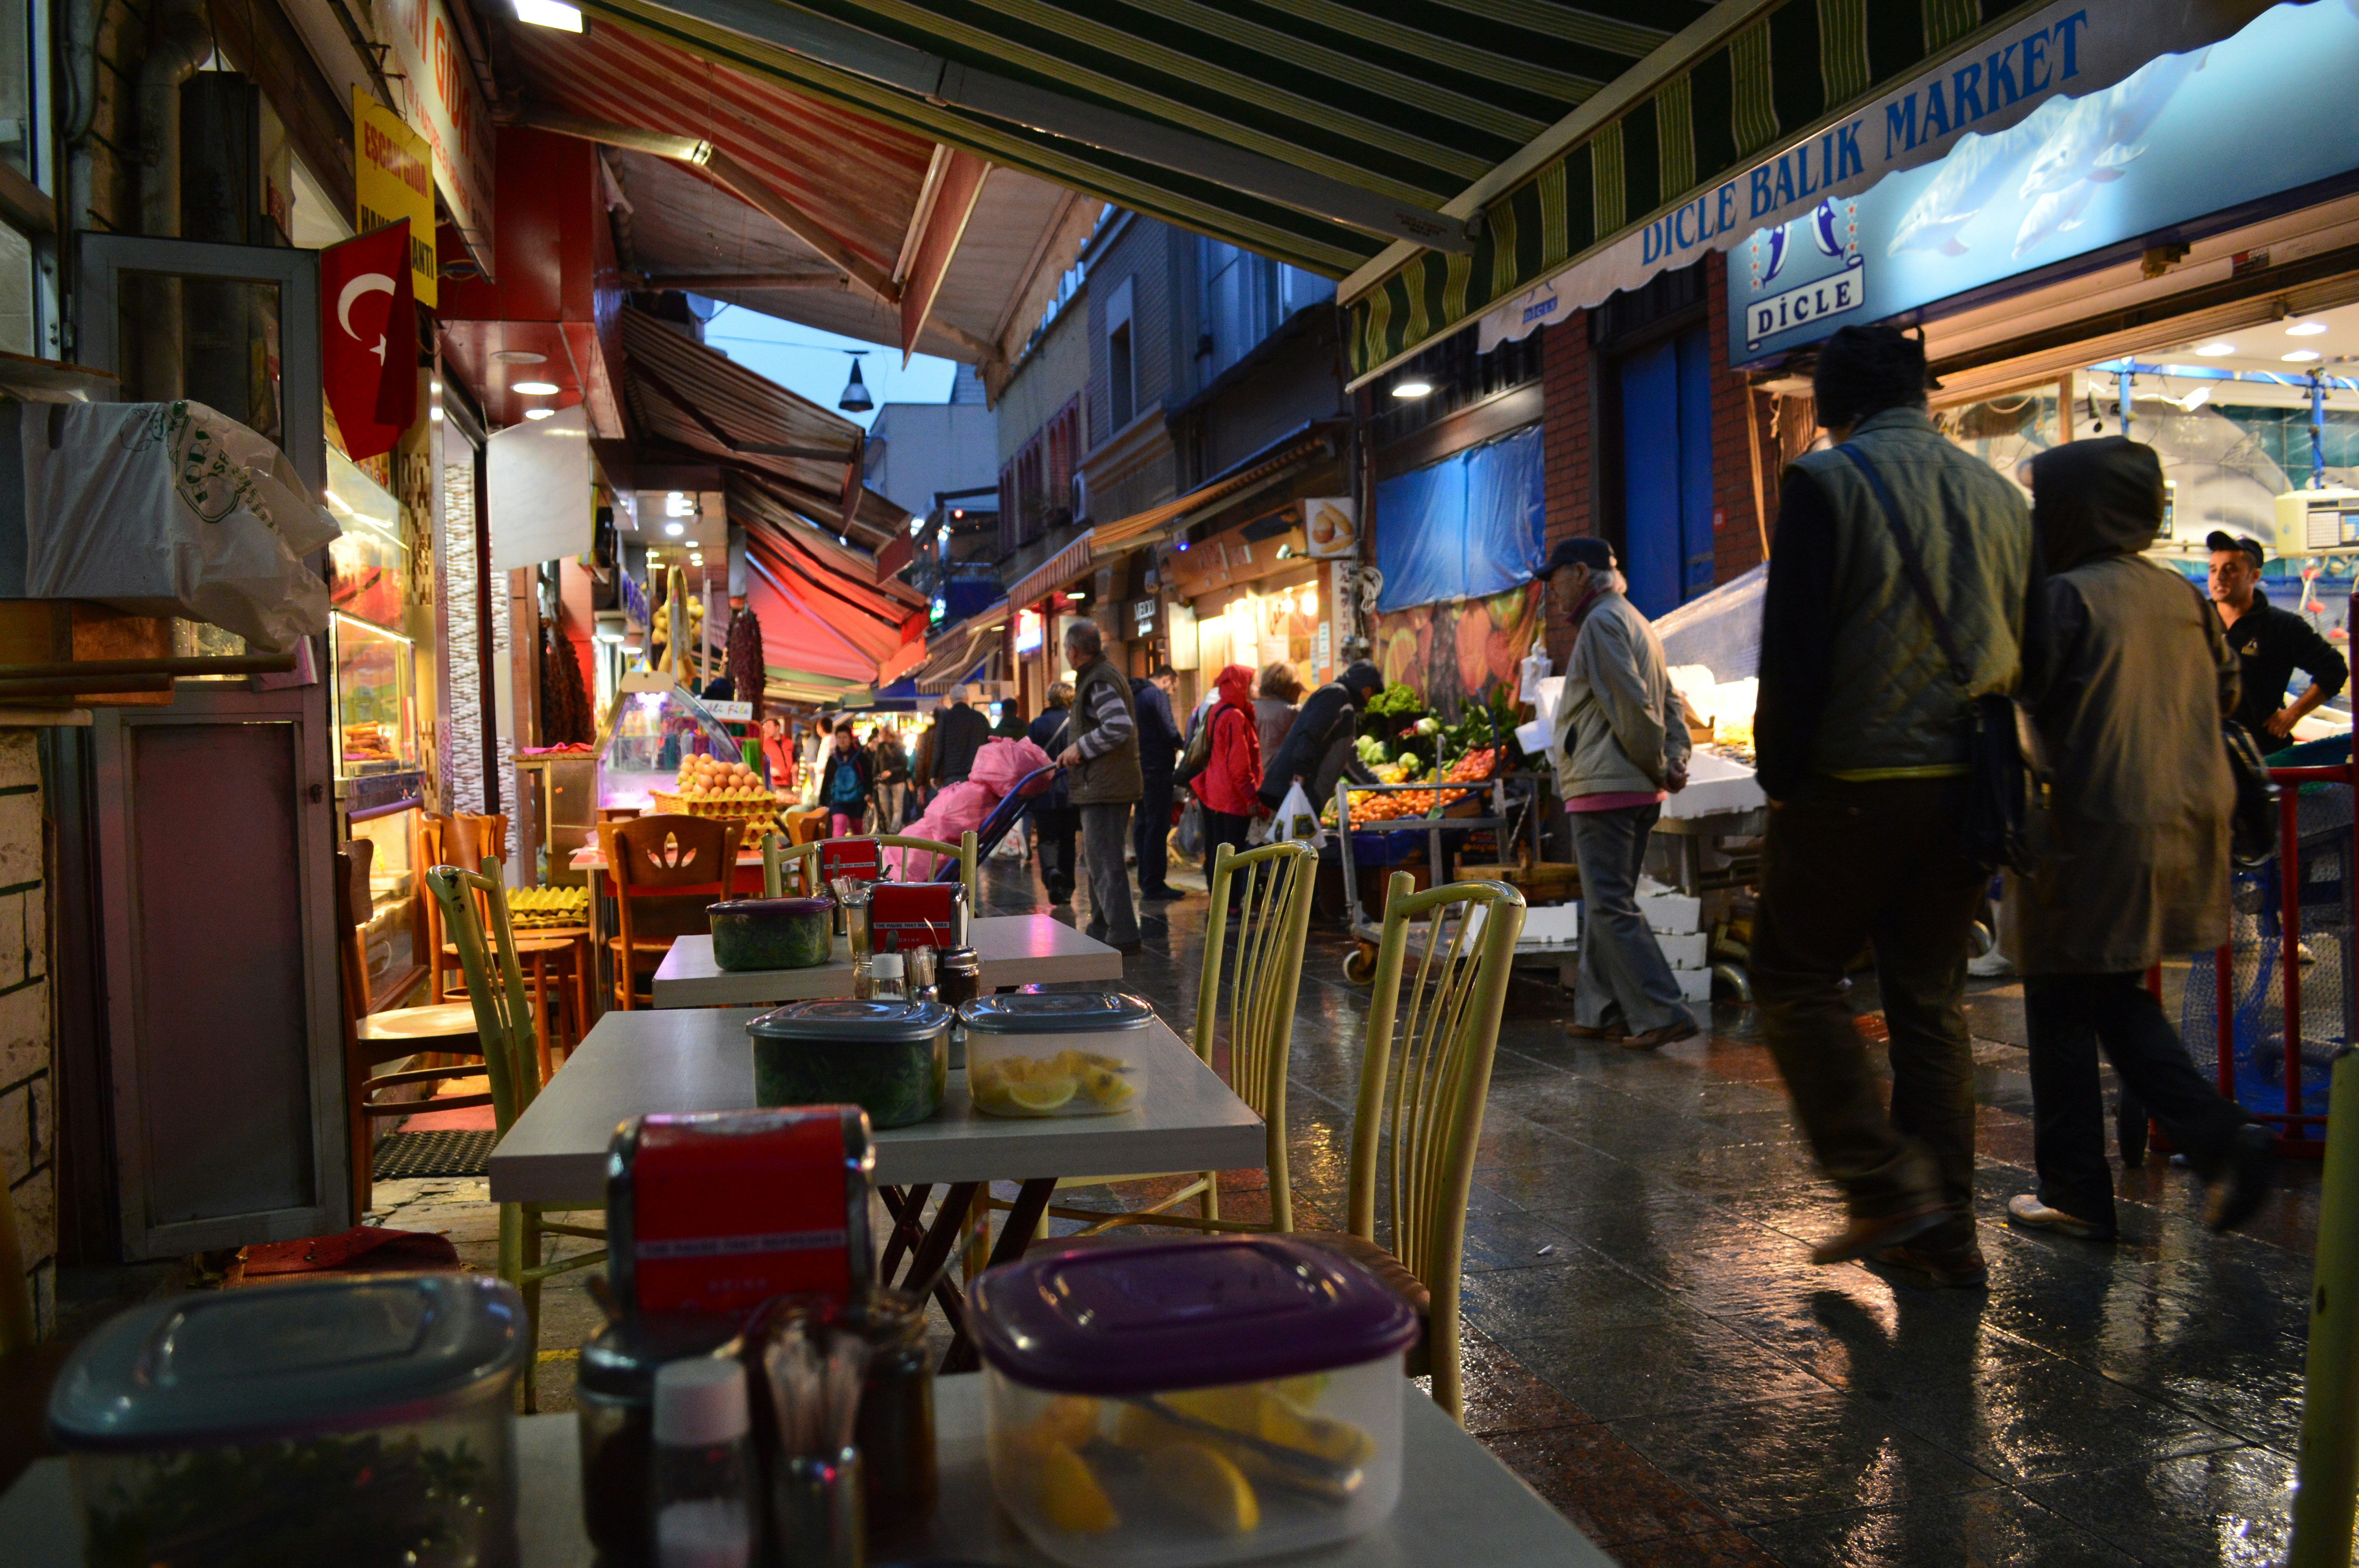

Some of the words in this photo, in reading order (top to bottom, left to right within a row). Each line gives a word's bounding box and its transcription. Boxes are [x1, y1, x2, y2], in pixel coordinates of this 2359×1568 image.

[1749, 119, 1865, 220] BALIK
[1885, 9, 2088, 161] MARKET
[411, 235, 434, 280] ANTI
[1758, 280, 1851, 334] DİCLE
